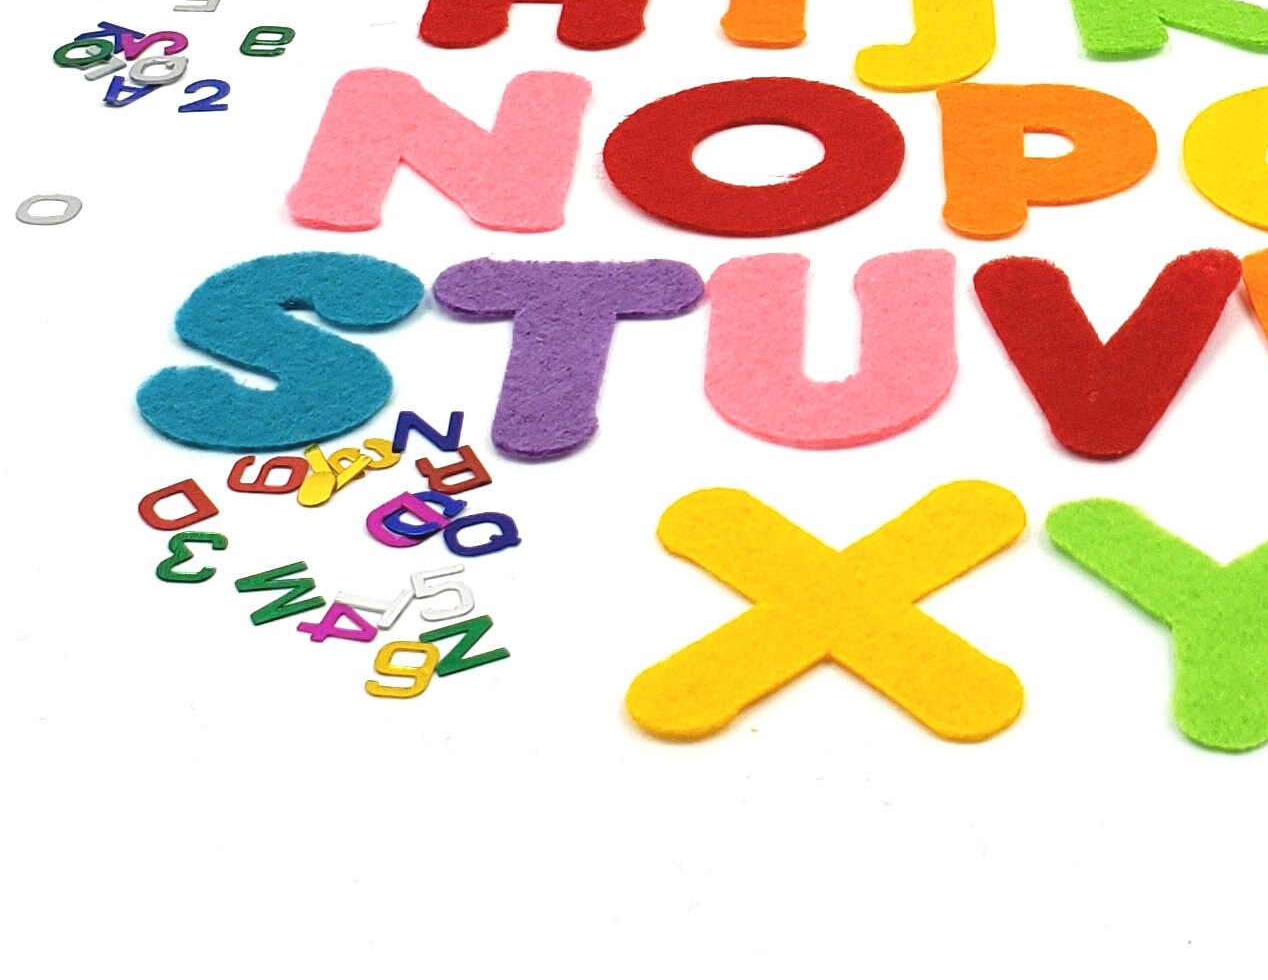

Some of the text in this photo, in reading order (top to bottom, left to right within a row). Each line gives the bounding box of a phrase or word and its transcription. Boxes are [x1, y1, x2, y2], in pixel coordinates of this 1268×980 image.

[178, 78, 231, 113] 2
[286, 70, 590, 229] N
[602, 77, 905, 238] O
[937, 80, 1159, 239] P
[136, 252, 424, 452] S
[432, 260, 704, 461] T
[704, 251, 956, 450] U
[973, 249, 1241, 460] V
[391, 410, 465, 454] N
[137, 477, 220, 532] D
[442, 511, 523, 558] Q
[410, 562, 476, 623] 5
[624, 479, 1028, 742] X
[295, 600, 379, 644] 4
